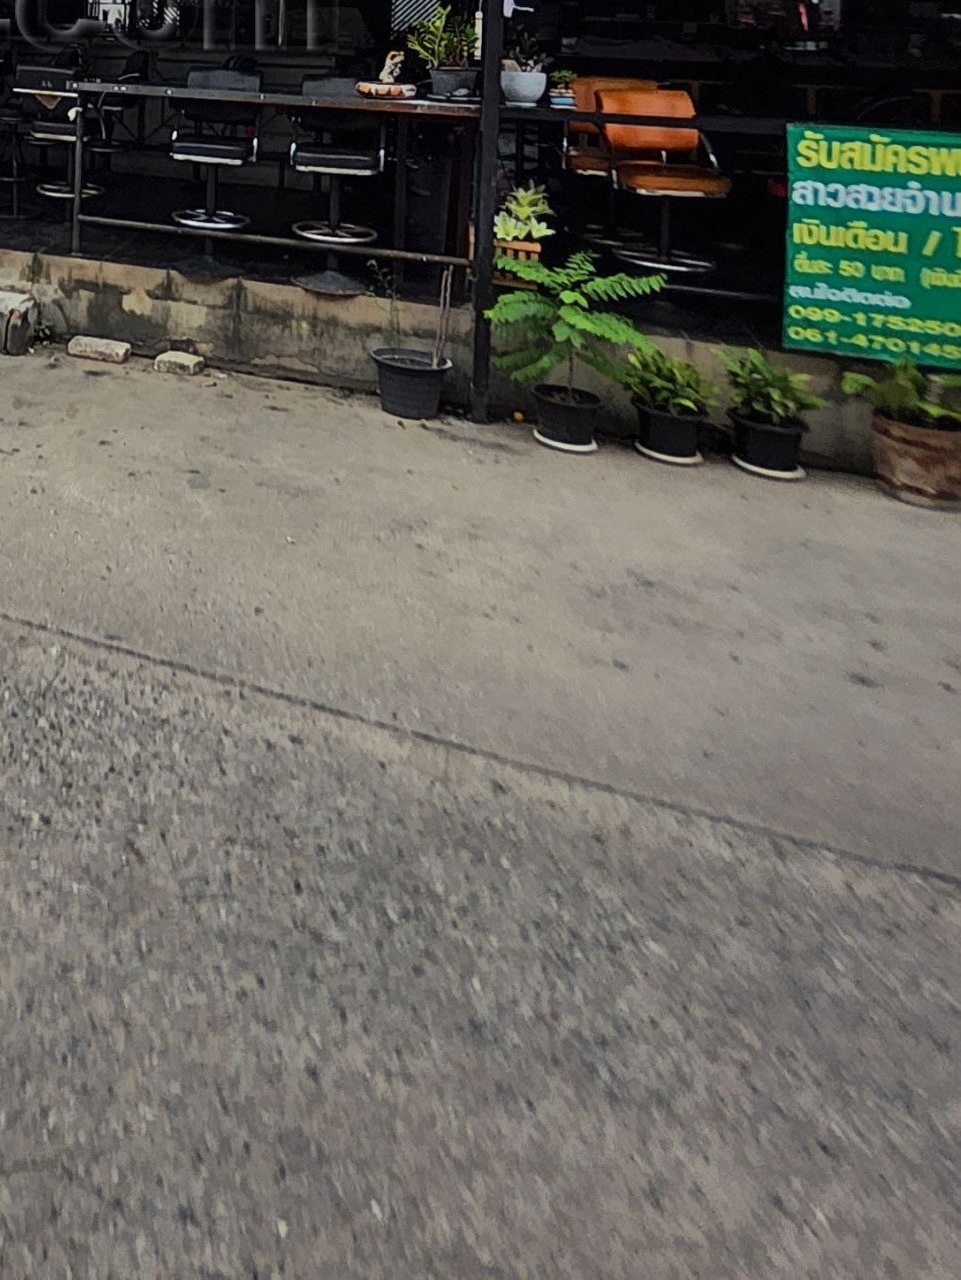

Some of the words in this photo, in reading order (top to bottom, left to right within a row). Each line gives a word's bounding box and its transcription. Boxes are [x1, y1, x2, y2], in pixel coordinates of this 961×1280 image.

[796, 130, 961, 177] รับสมัครพ
[792, 218, 908, 255] เงินเดือน
